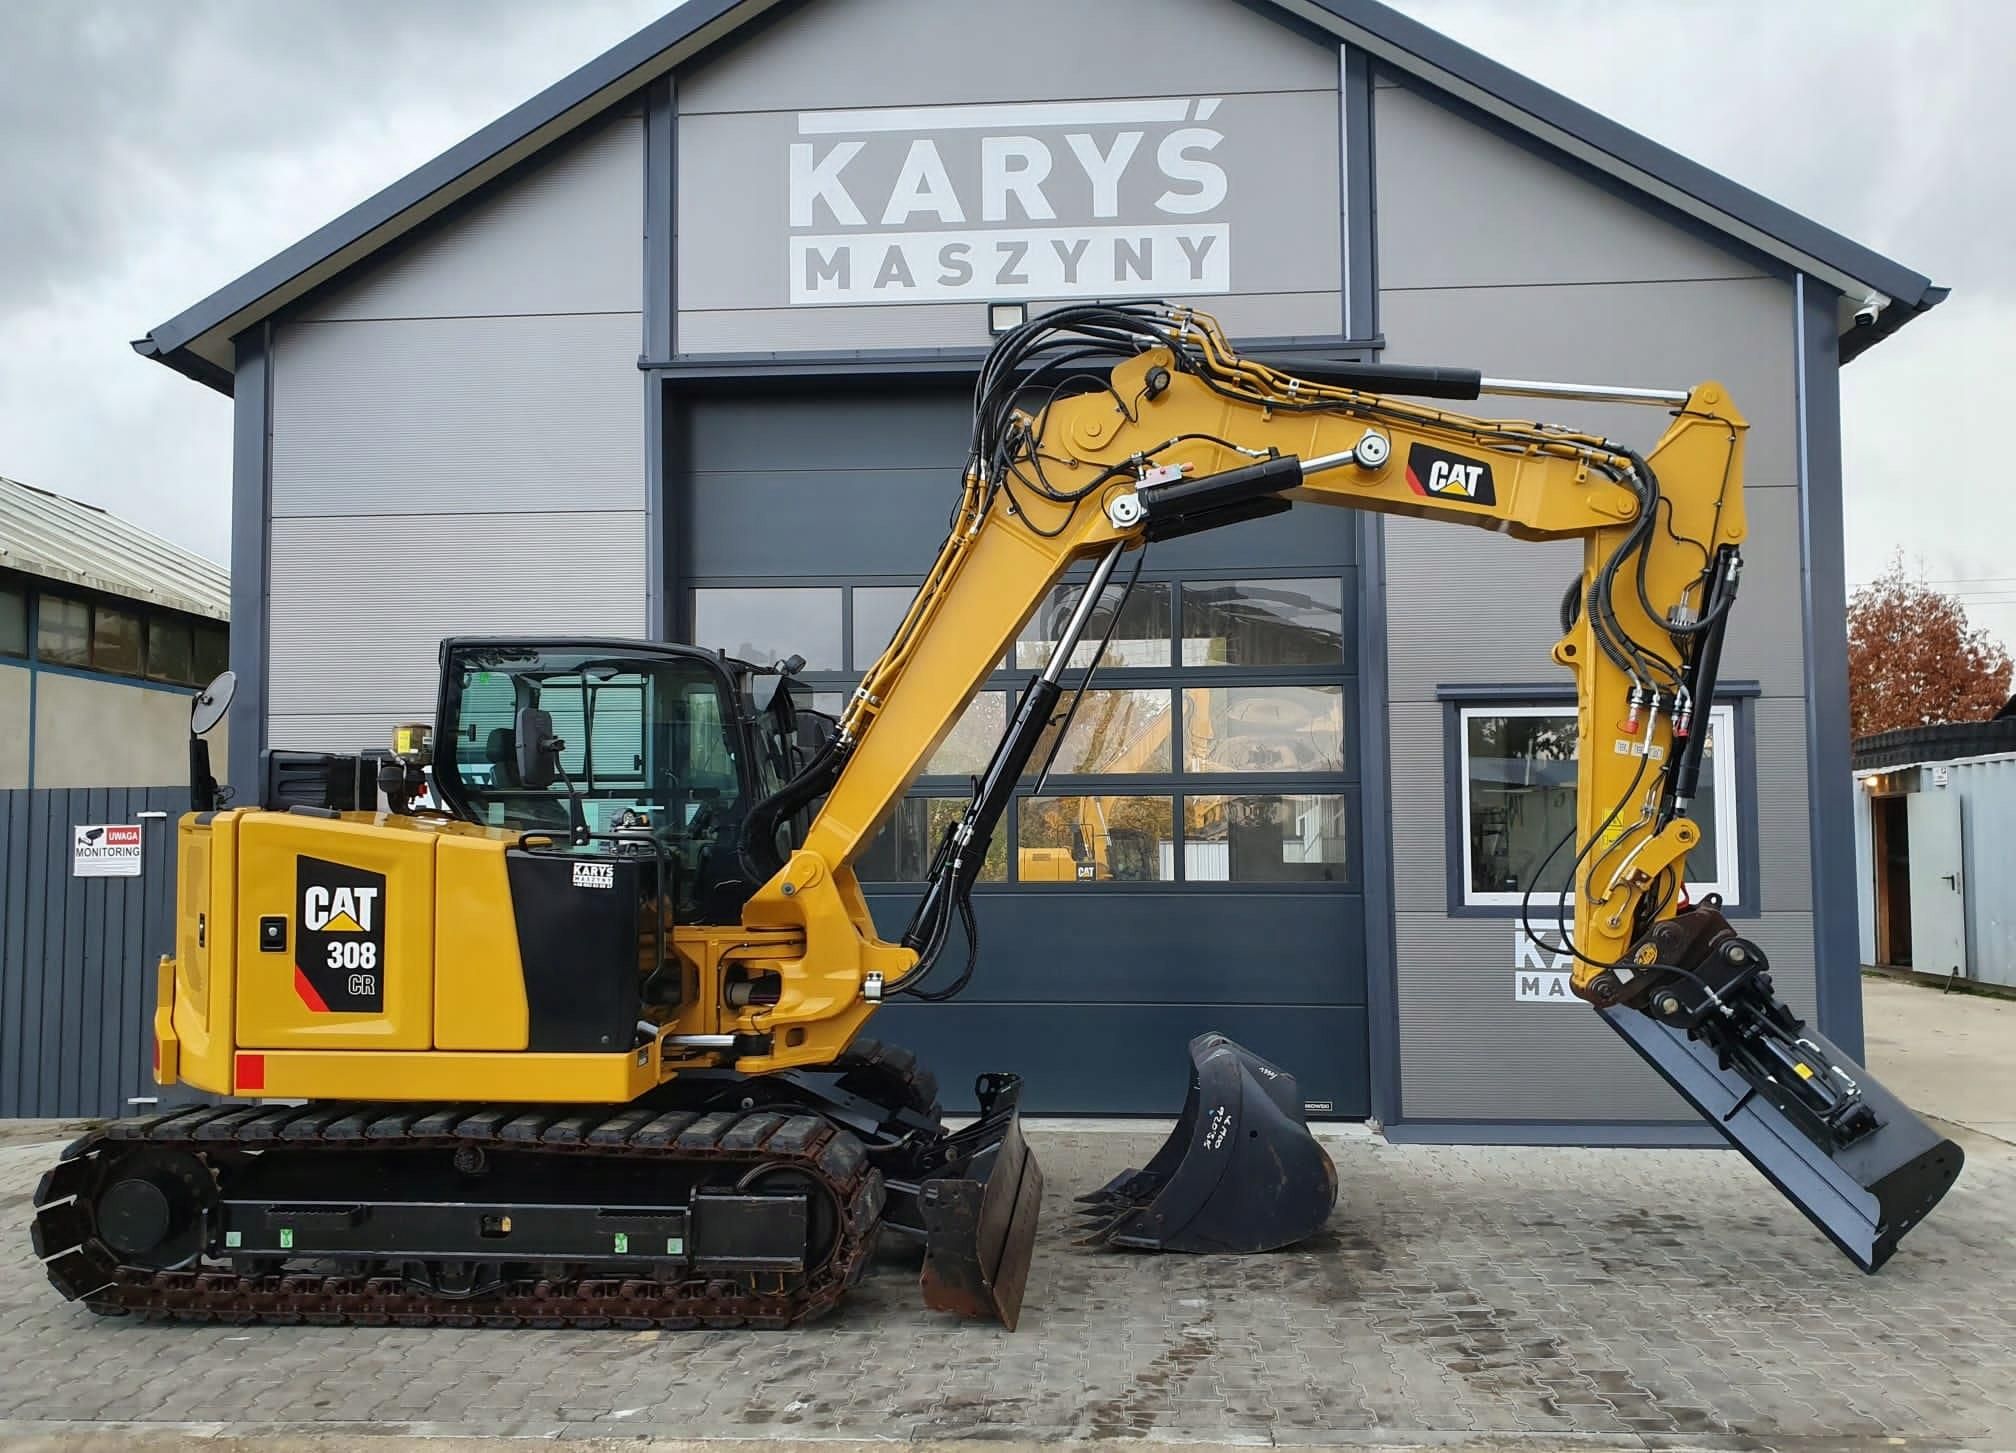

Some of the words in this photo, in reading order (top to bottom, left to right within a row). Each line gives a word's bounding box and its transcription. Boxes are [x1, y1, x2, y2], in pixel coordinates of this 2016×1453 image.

[789, 98, 1228, 227] KARYŚ
[805, 235, 1217, 291] MASZYNY
[1429, 460, 1483, 497] CAT
[108, 829, 138, 841] UWAGA
[75, 847, 140, 857] MONITORING
[1079, 867, 1094, 878] CAT
[305, 885, 378, 932] CAT
[327, 941, 376, 969] 308
[348, 974, 375, 995] CR
